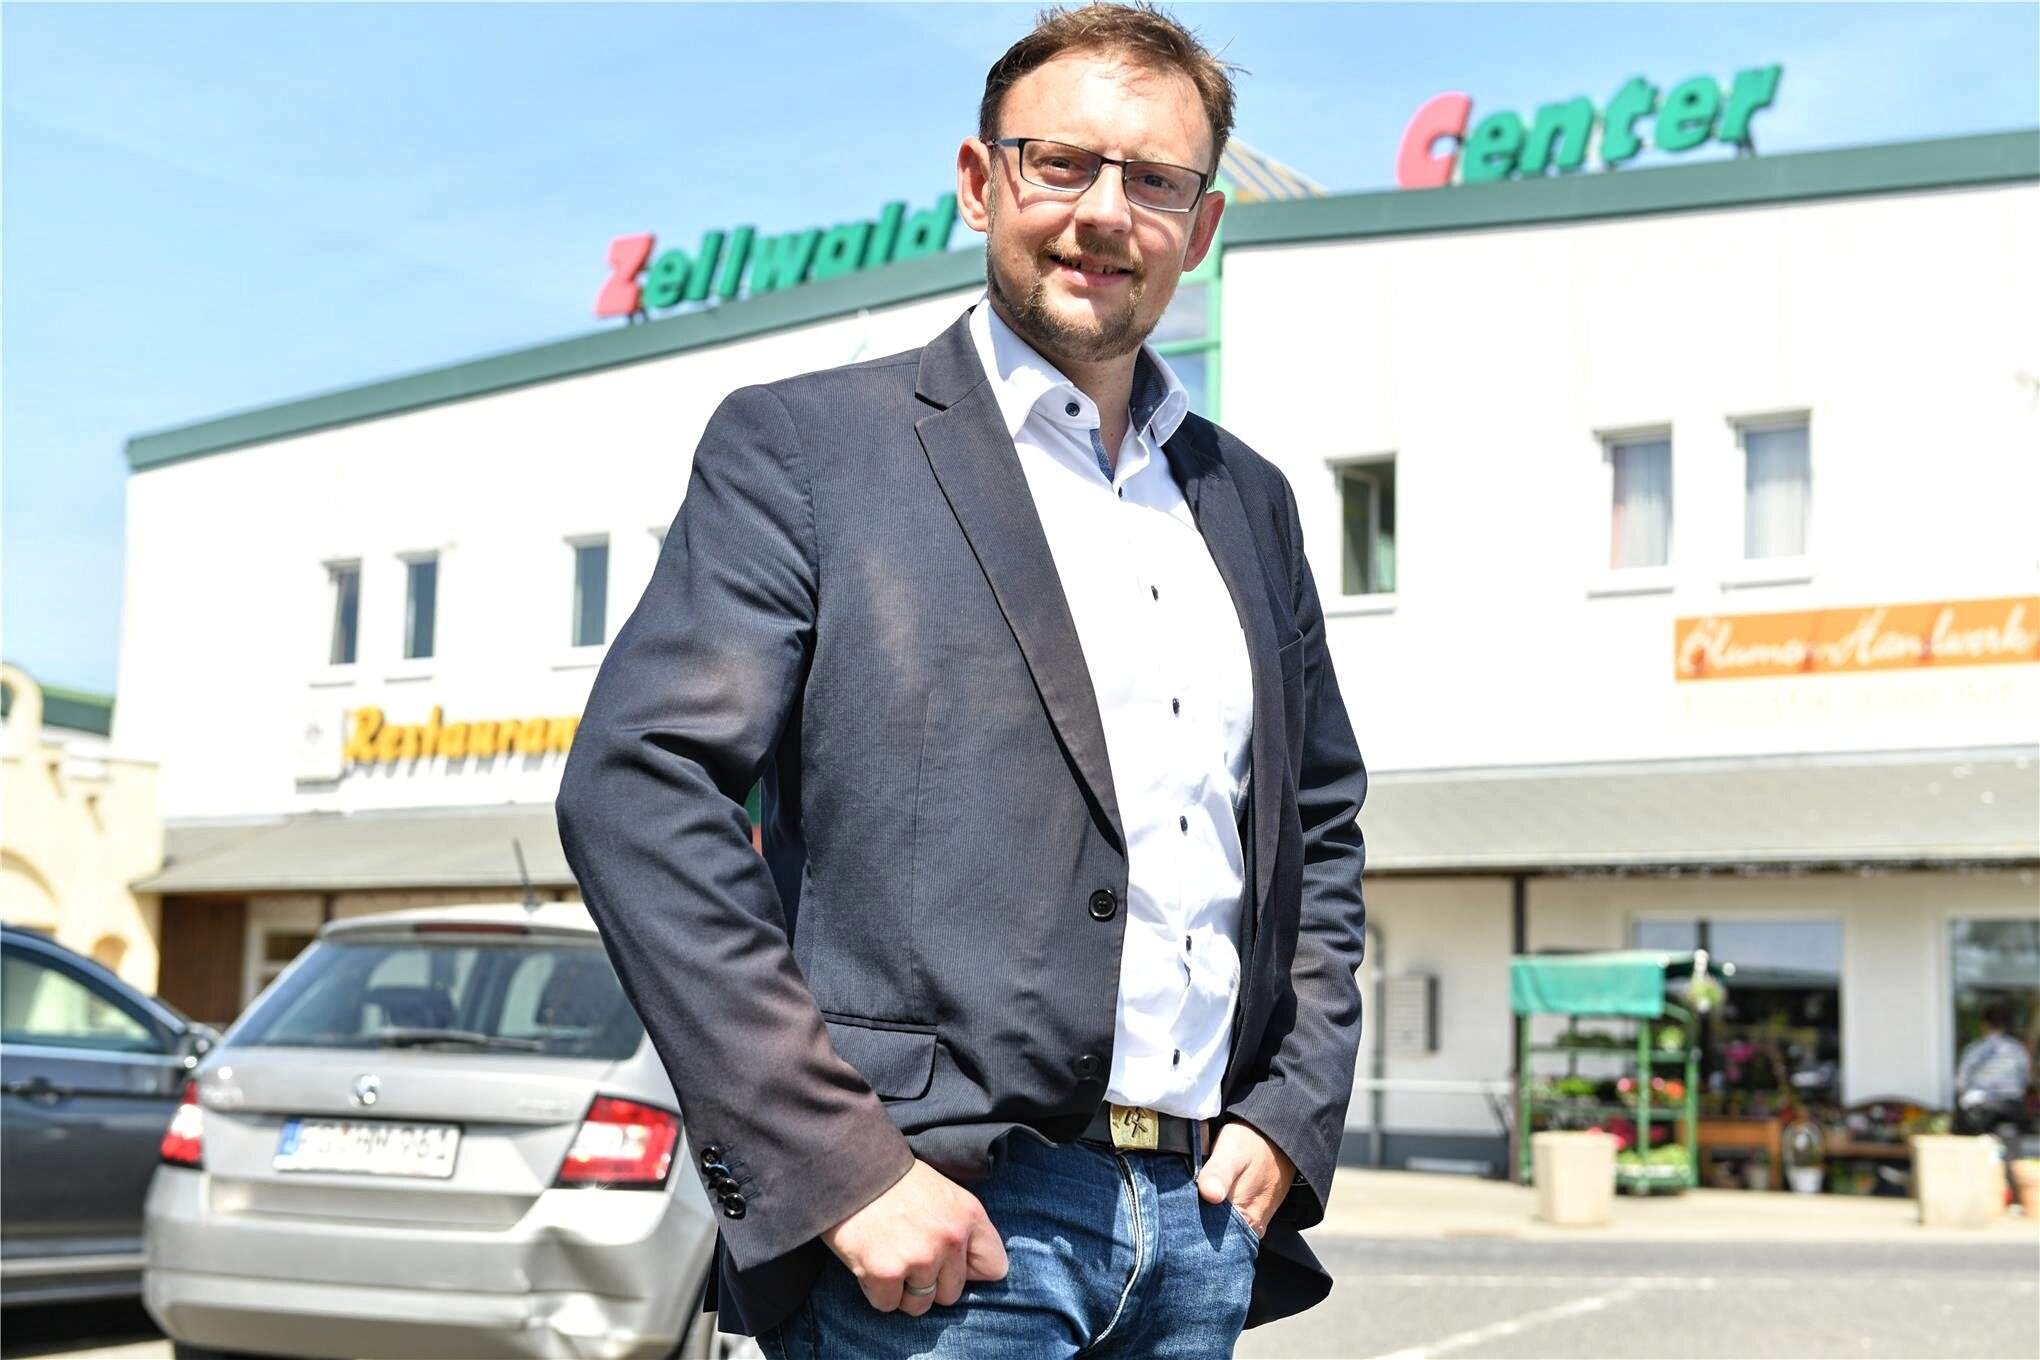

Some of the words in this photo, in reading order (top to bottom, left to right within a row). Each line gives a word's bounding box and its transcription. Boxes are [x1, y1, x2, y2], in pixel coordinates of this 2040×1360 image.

[595, 192, 959, 318] Zellwald
[1395, 63, 1783, 189] Center
[343, 703, 580, 763] Restauran
